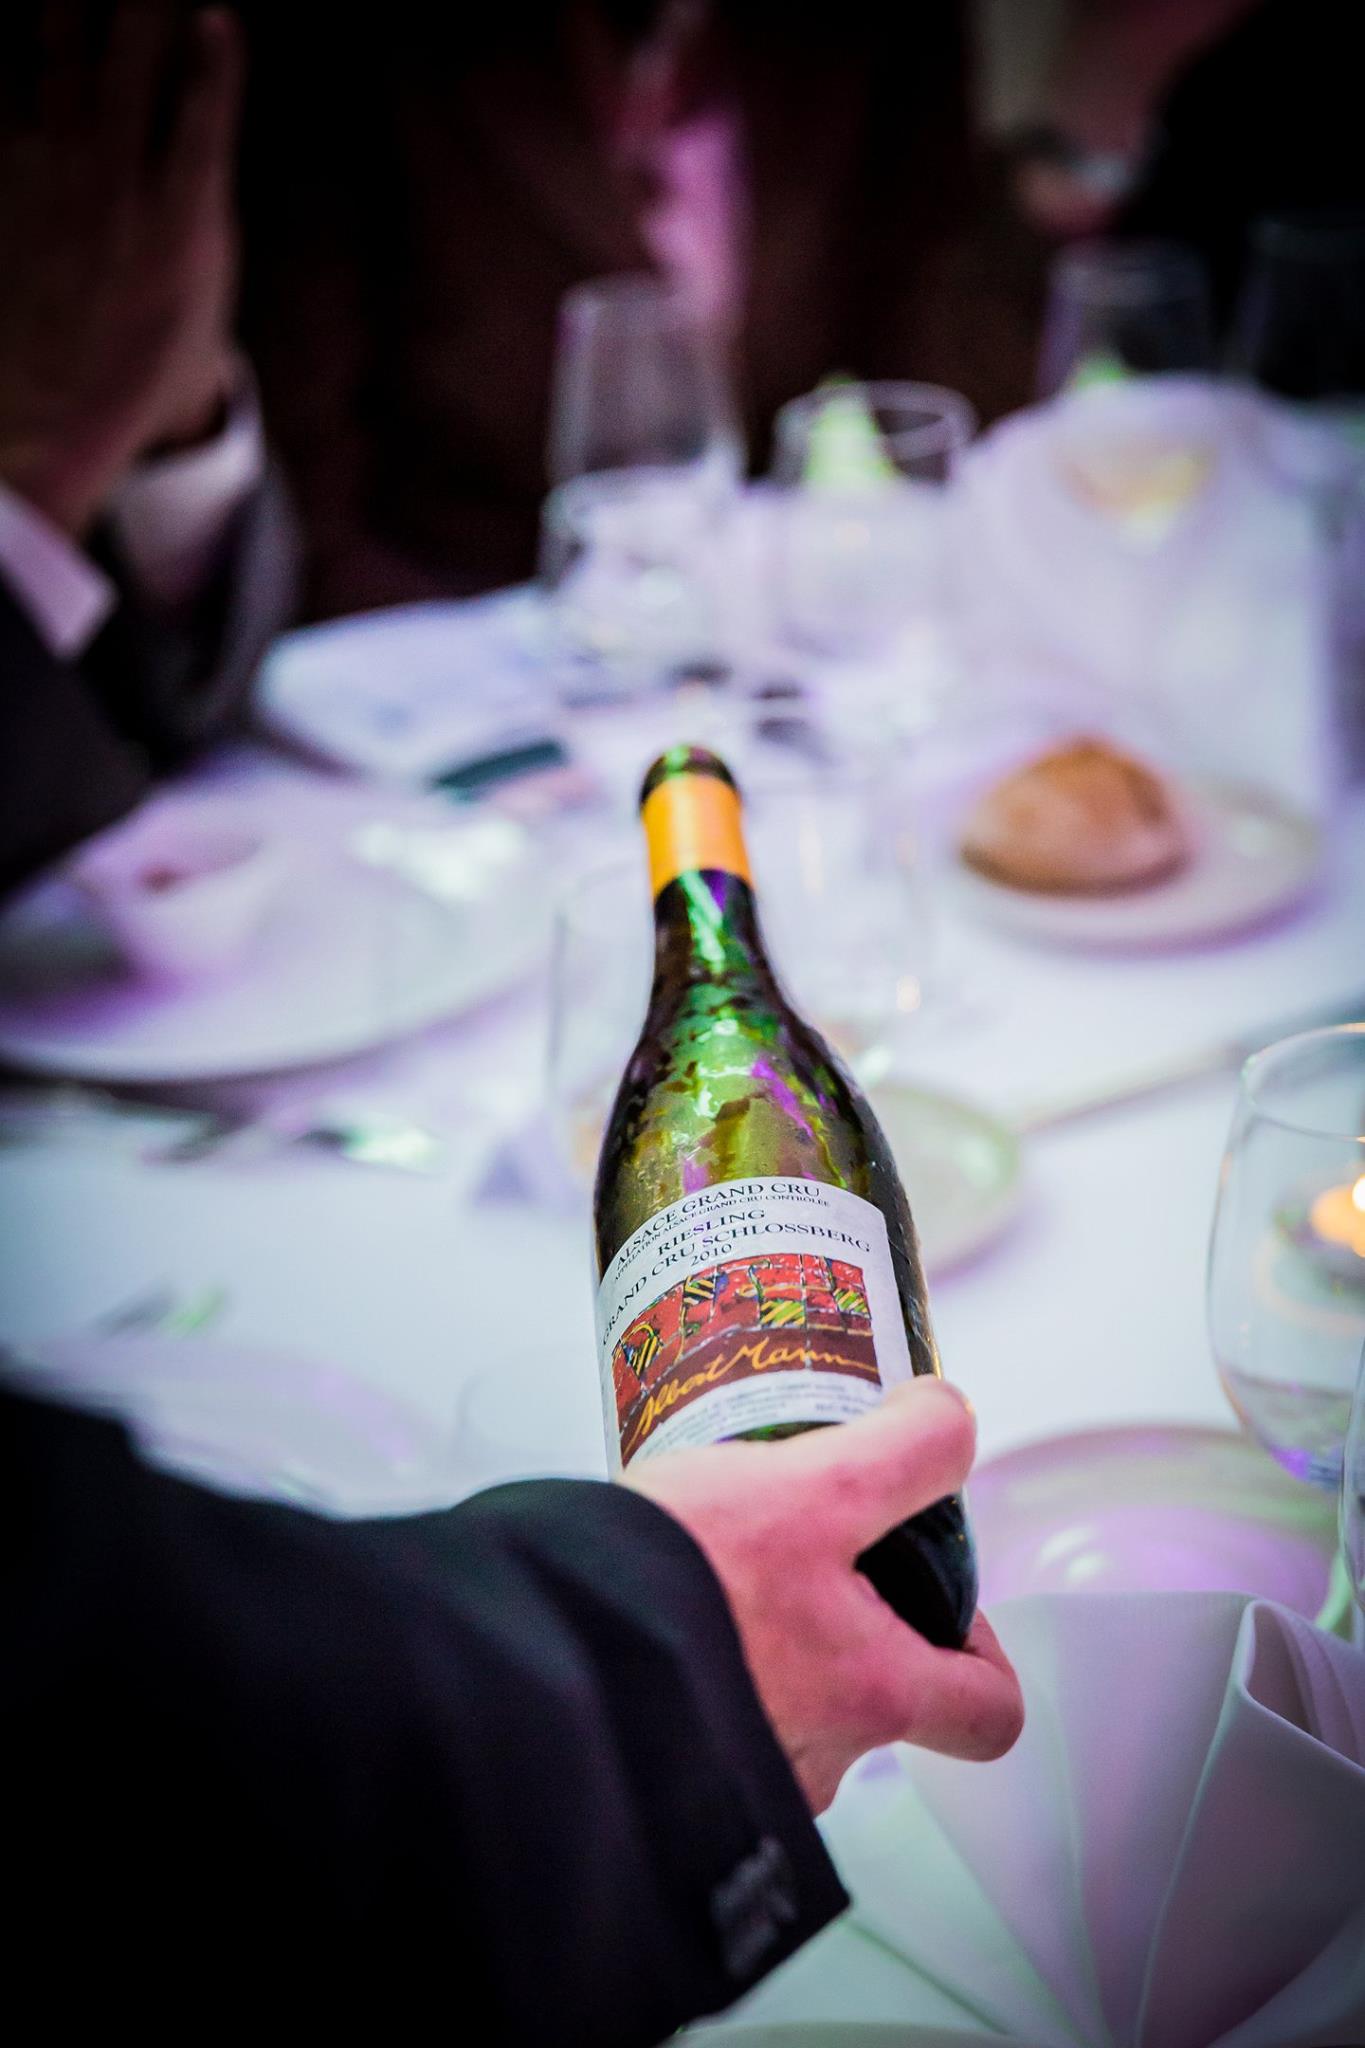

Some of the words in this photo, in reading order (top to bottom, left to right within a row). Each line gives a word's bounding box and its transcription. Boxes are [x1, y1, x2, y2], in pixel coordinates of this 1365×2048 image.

[617, 1209, 677, 1270] ALSACE
[682, 1184, 764, 1213] GRAND
[771, 1183, 820, 1198] CRU
[658, 1209, 766, 1255] RIESLING
[691, 1243, 732, 1266] 2010
[603, 1276, 647, 1346] GRAND
[651, 1243, 695, 1276] CRU
[702, 1222, 871, 1253] SCHLOSSBERG
